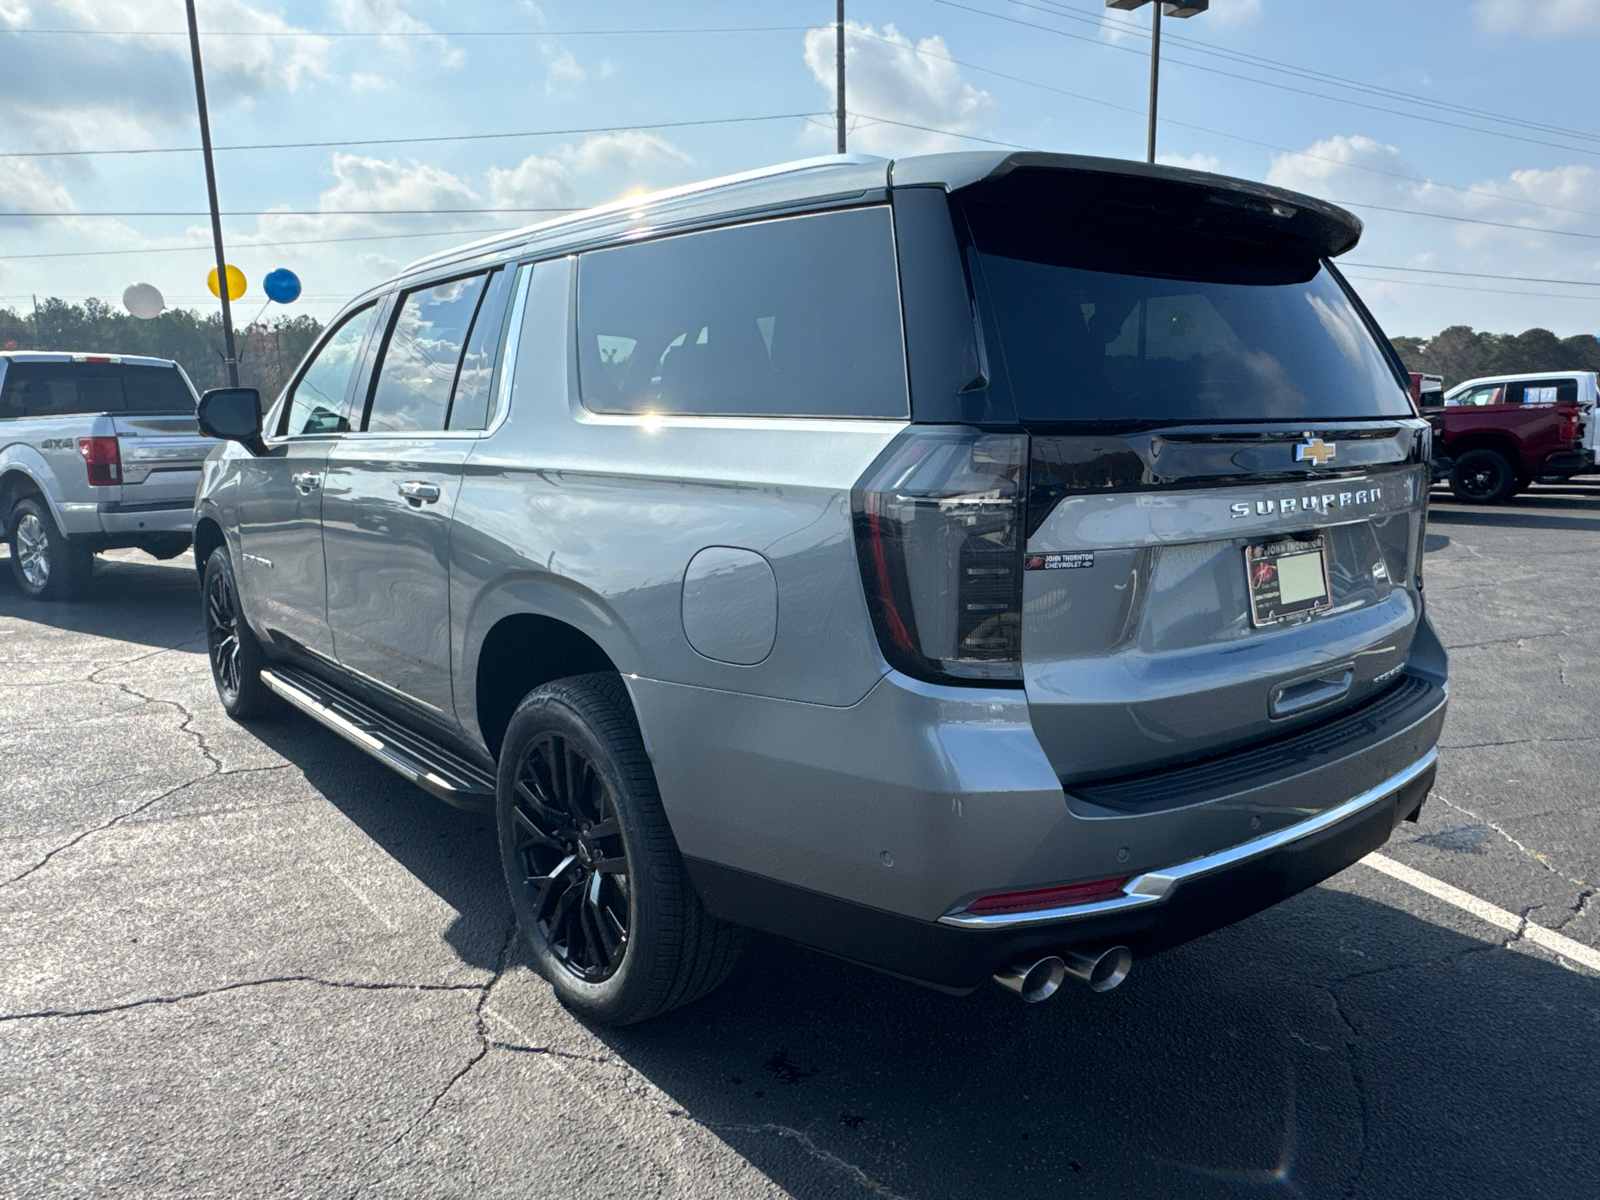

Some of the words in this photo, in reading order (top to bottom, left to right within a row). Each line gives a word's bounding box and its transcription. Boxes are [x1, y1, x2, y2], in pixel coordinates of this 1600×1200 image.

[1230, 488, 1381, 519] SUBURBAN
[1267, 543, 1286, 556] JOHN
[1045, 554, 1061, 563] JOHN
[1062, 553, 1094, 562] THORNTON
[1045, 561, 1082, 569] CHEVROLET
